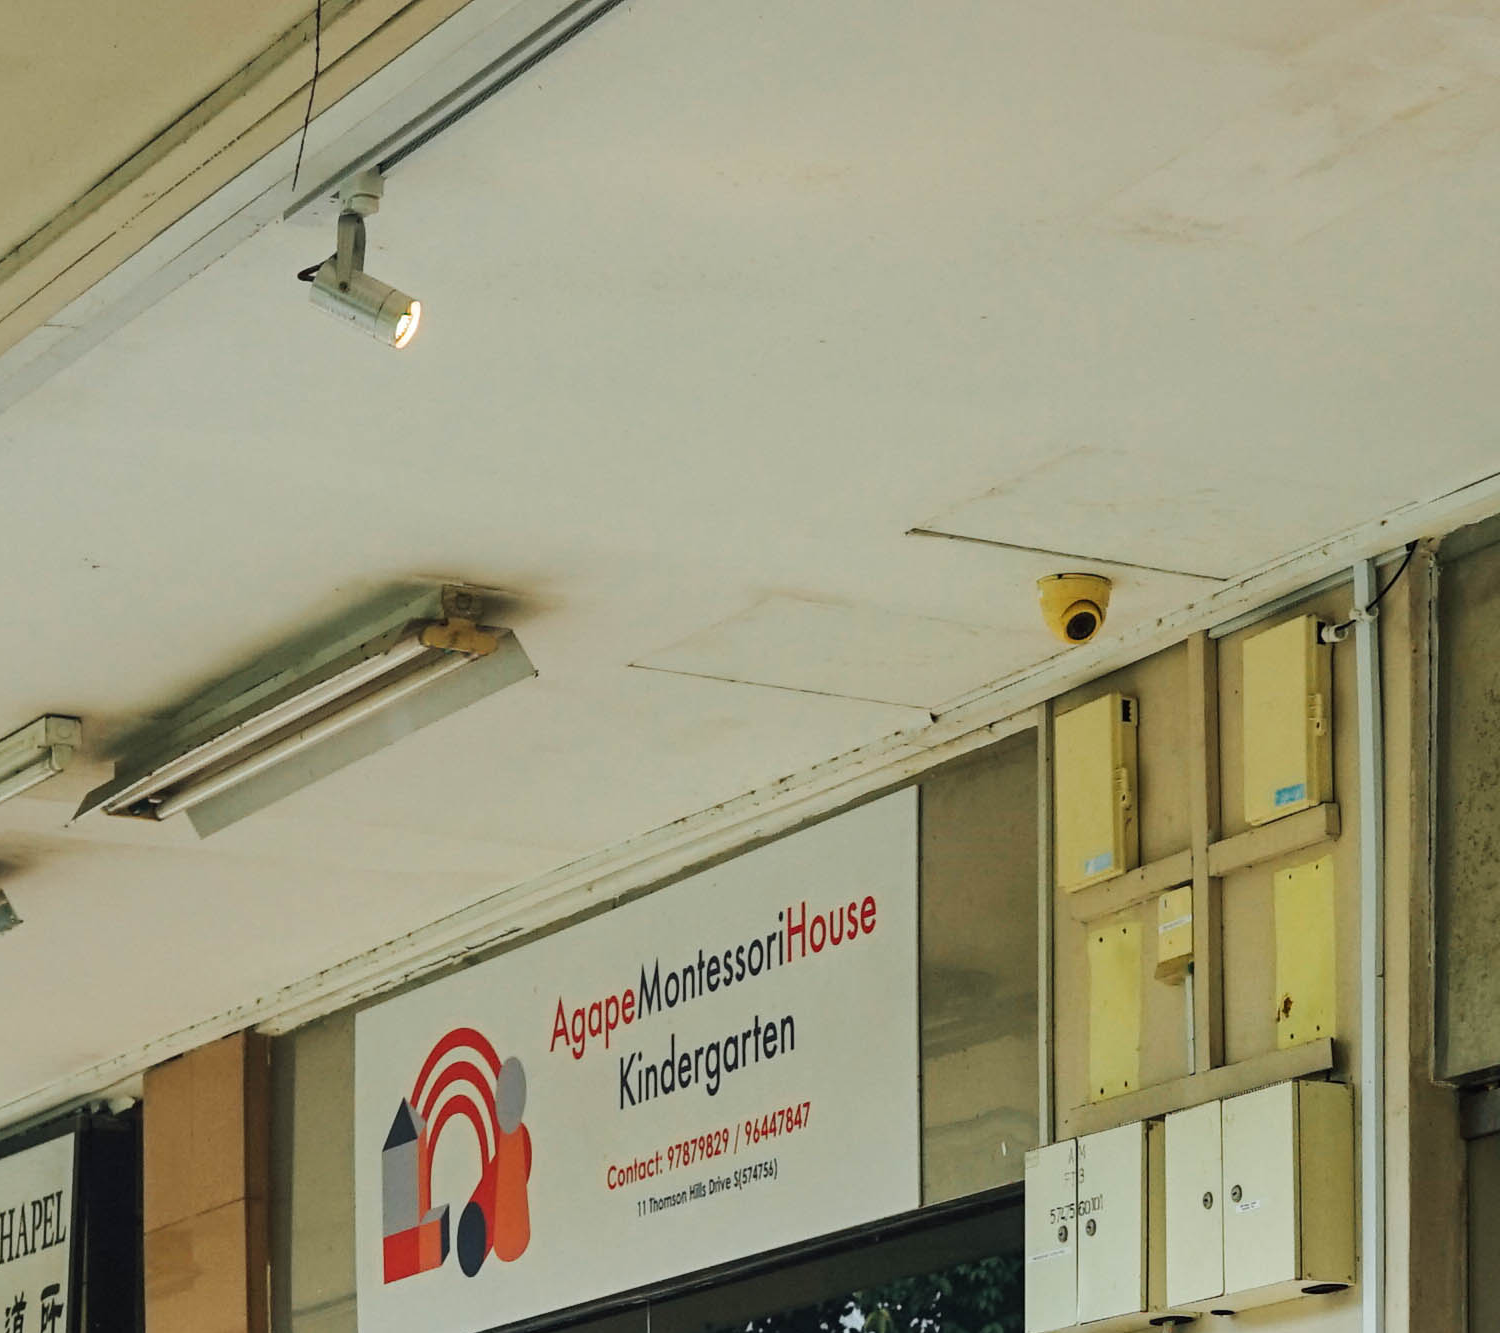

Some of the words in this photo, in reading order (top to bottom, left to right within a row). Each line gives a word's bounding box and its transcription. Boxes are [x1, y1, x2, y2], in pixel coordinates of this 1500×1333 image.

[550, 895, 876, 1059] AgapeMontessoriHouse
[620, 1014, 795, 1110] Kindergarten
[607, 1154, 663, 1190] Contact:
[667, 1128, 729, 1171] 97879829
[733, 1124, 740, 1154] /
[745, 1102, 811, 1148] 96447847
[637, 1200, 647, 1217] 11
[649, 1188, 687, 1214] Thomson
[689, 1180, 707, 1201] Hills
[708, 1175, 731, 1195] Drive
